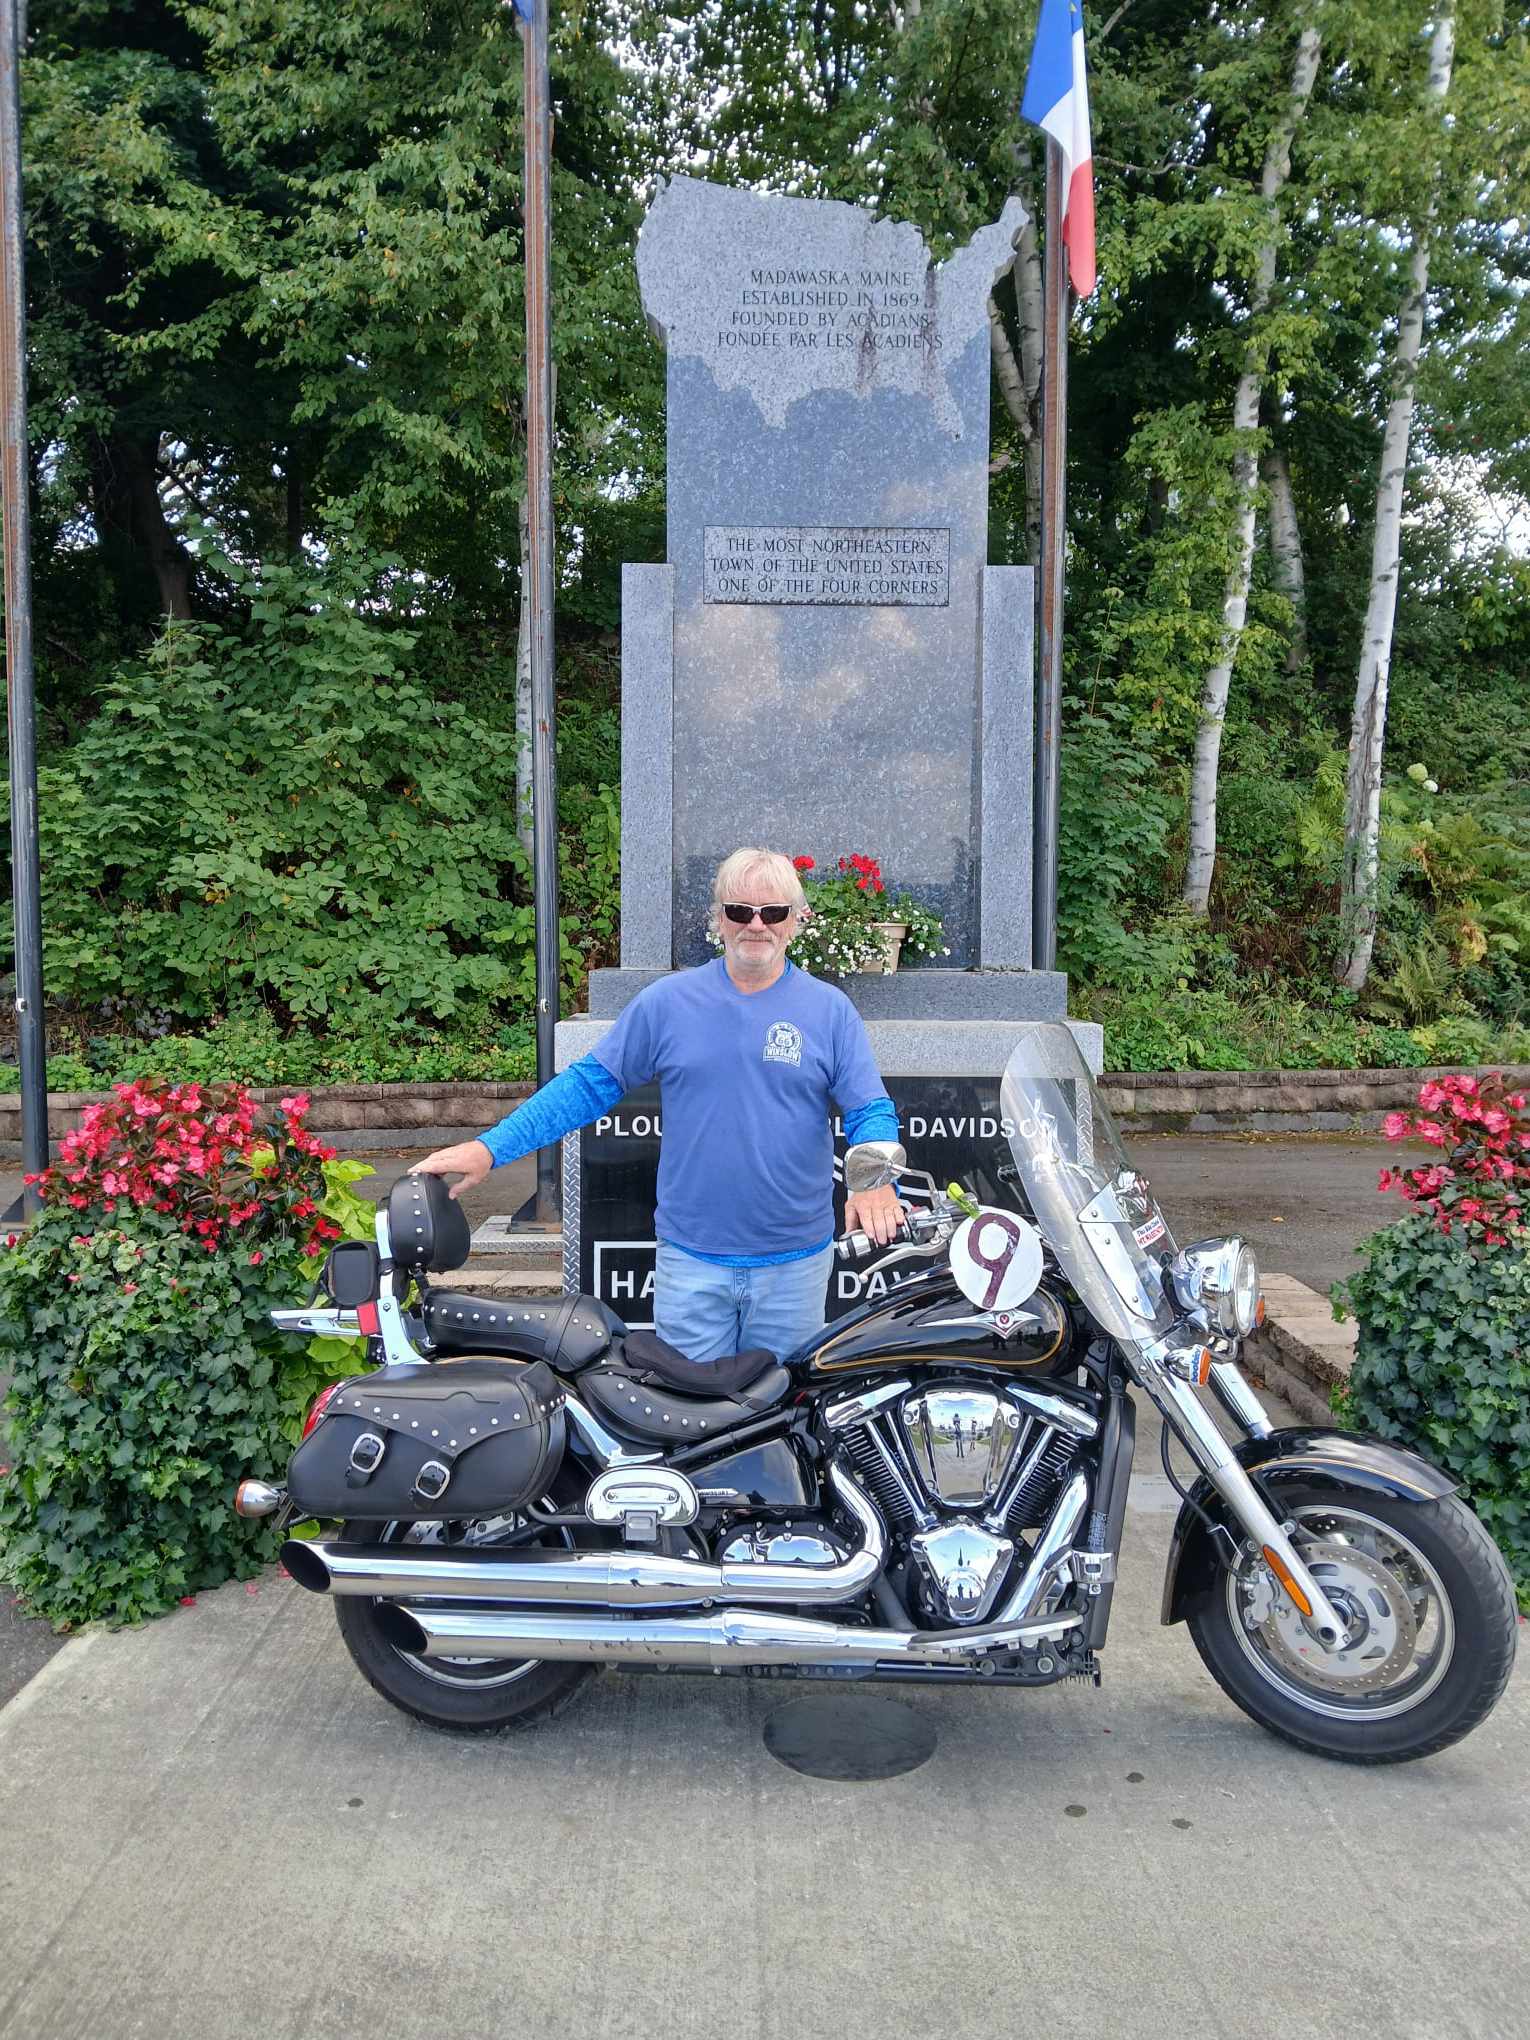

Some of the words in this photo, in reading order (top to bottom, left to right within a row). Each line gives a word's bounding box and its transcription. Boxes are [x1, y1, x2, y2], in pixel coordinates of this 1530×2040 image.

[750, 270, 850, 286] MADAWASKA
[860, 271, 913, 286] MAINE
[742, 290, 848, 306] ESTABLISHED
[857, 291, 874, 306] IN
[883, 292, 920, 307] 1869
[732, 311, 809, 326] FOUNDED
[818, 311, 838, 327] BY
[849, 312, 930, 328] ACADIANS
[717, 324, 779, 346] FONDÉE
[790, 333, 817, 347] PAR
[827, 333, 853, 347] LES
[862, 333, 943, 349] ACADIENS
[727, 538, 753, 552] THE
[764, 538, 801, 553] MOST
[813, 539, 931, 554] NORTHEASTERN
[711, 557, 754, 572] TOWN
[763, 558, 783, 573] OF
[790, 558, 818, 573] THE
[826, 559, 882, 574] UNITED
[891, 560, 944, 575] STATES
[718, 578, 750, 592] ONE
[757, 577, 777, 593] OF
[784, 579, 815, 593] THE
[822, 579, 861, 594] FOUR
[869, 580, 939, 595] CORNERS
[967, 1212, 1021, 1308] 9
